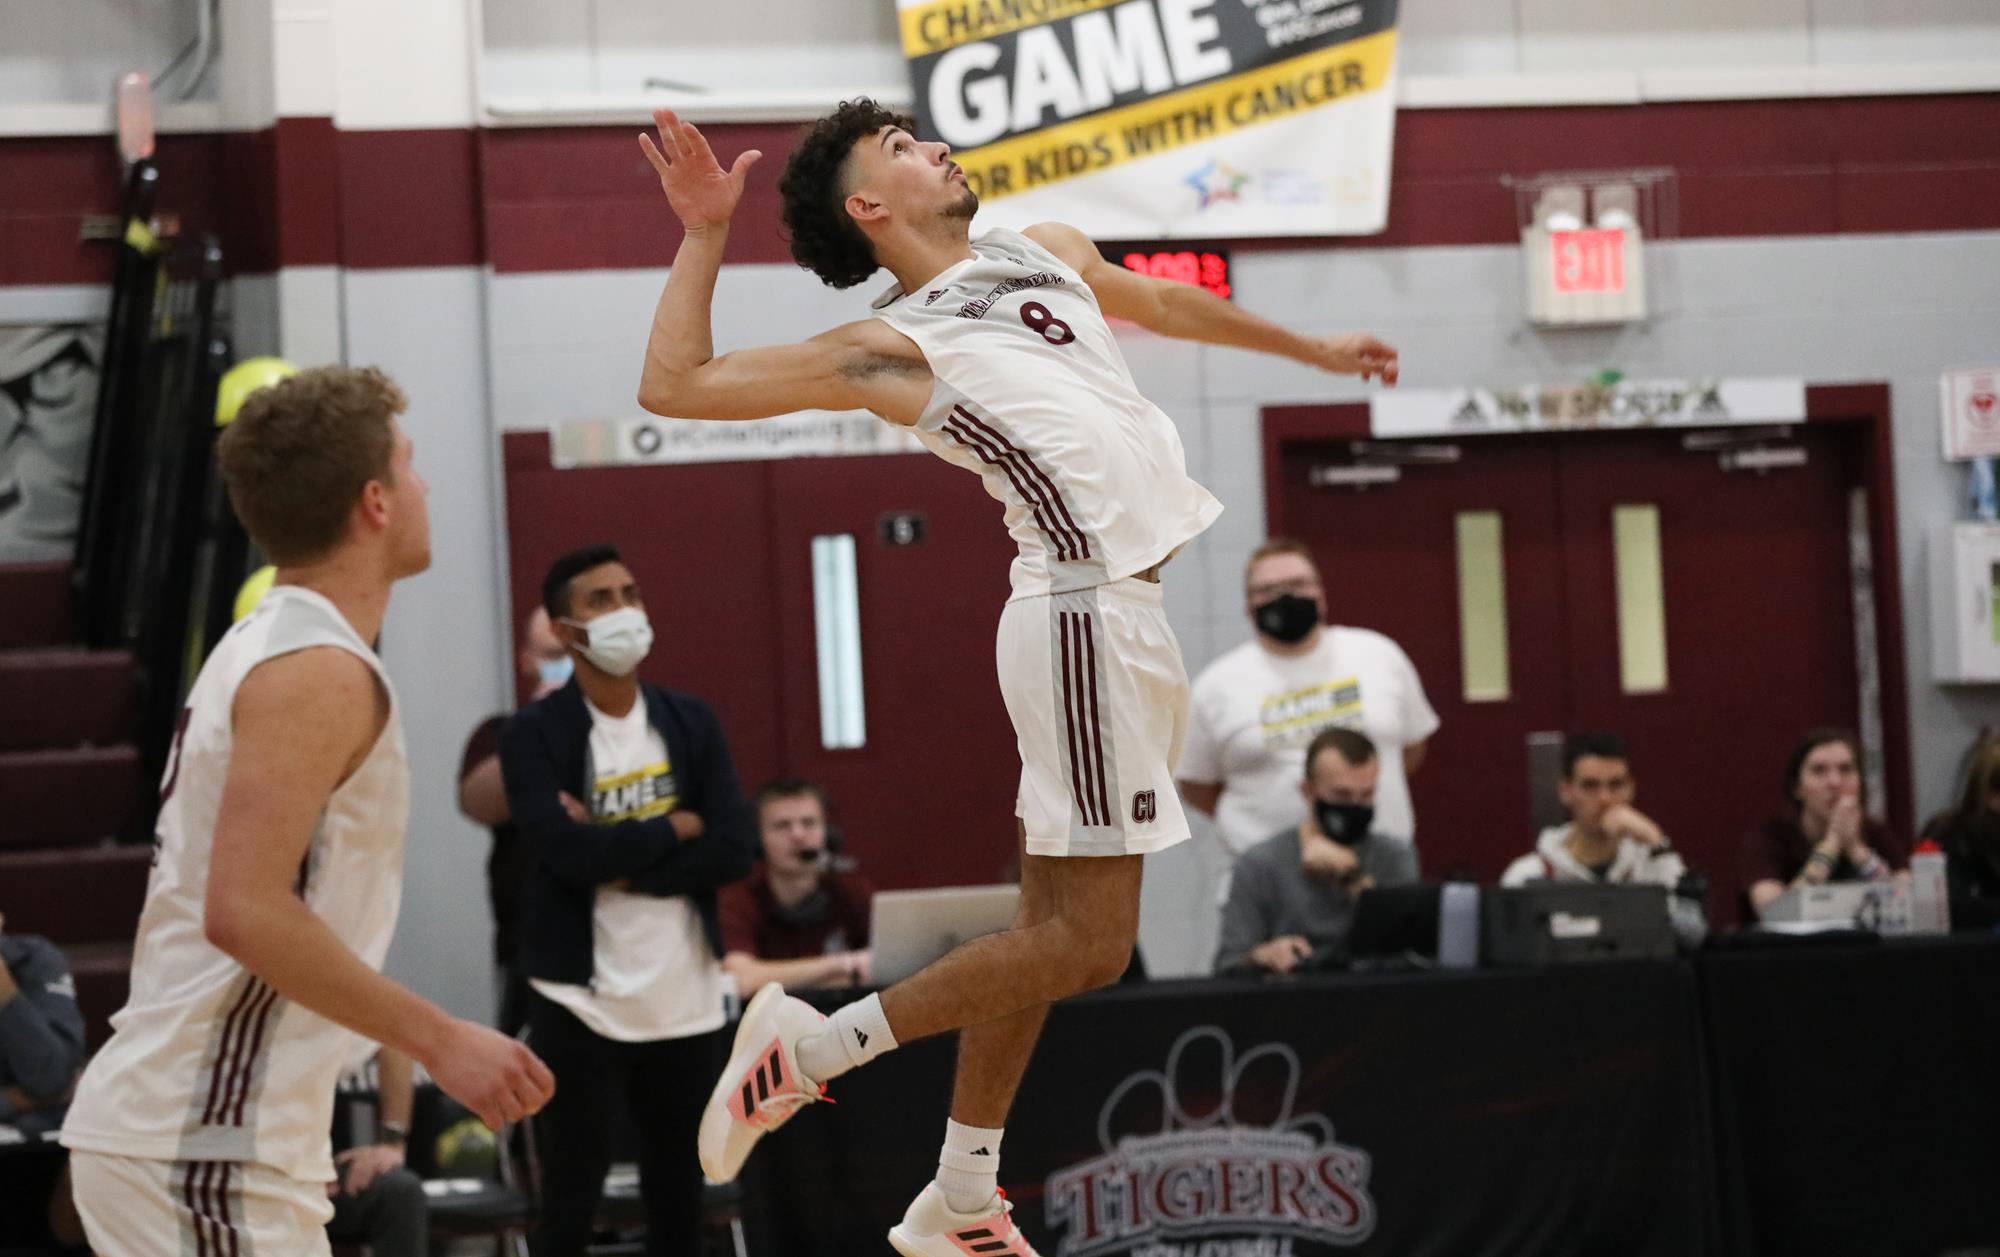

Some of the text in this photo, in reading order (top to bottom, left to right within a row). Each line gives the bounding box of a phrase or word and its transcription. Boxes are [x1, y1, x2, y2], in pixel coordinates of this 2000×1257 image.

[929, 0, 1232, 147] GAME
[1025, 138, 1114, 182] KIDS
[1122, 106, 1217, 157] WITH
[1226, 60, 1366, 127] CANCER
[1551, 229, 1625, 292] EXIT
[1019, 301, 1076, 345] 8
[1131, 789, 1156, 823] CU
[1052, 1149, 1370, 1241] TIGERS
